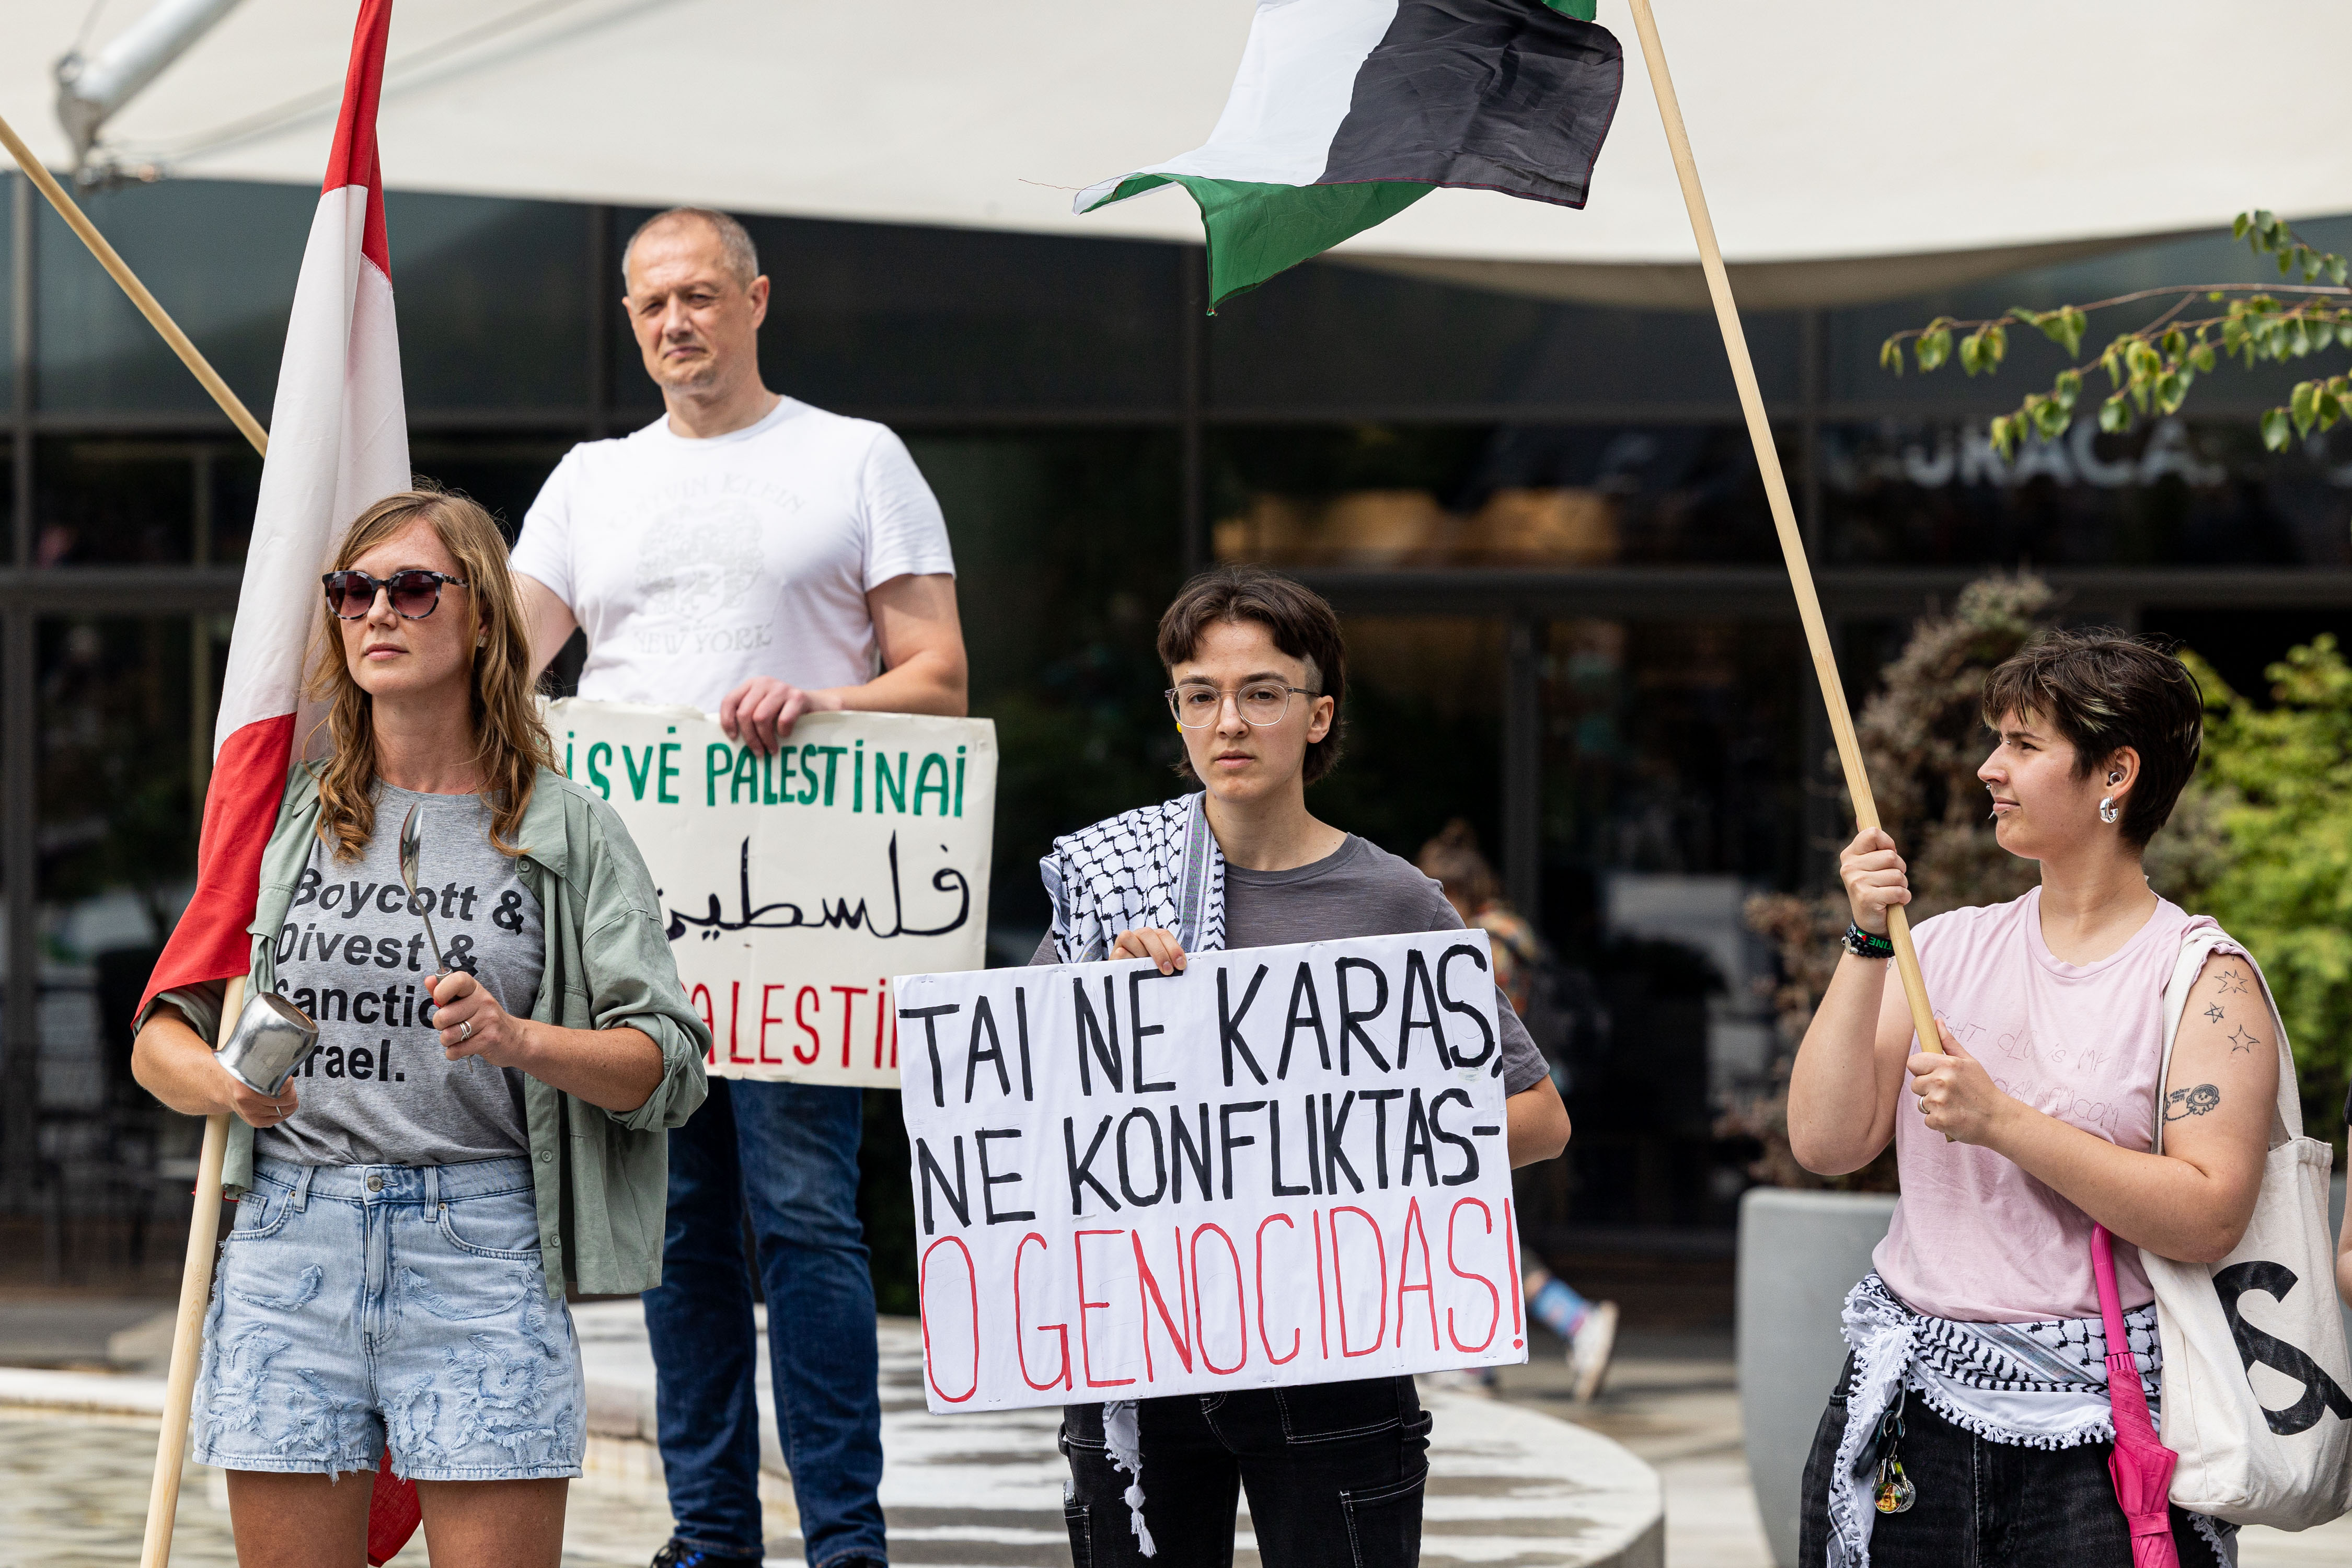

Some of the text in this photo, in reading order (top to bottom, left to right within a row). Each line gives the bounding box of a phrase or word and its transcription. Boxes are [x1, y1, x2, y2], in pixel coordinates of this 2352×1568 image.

[635, 621, 774, 654] NEW YORK
[276, 923, 479, 977] Divest &
[293, 868, 524, 936] Boycott &
[899, 944, 1505, 1107] TAI NE KARAS,
[916, 1088, 1501, 1235] NE KONFLIKTAS-
[920, 1196, 1524, 1403] O GENOCIDAS!
